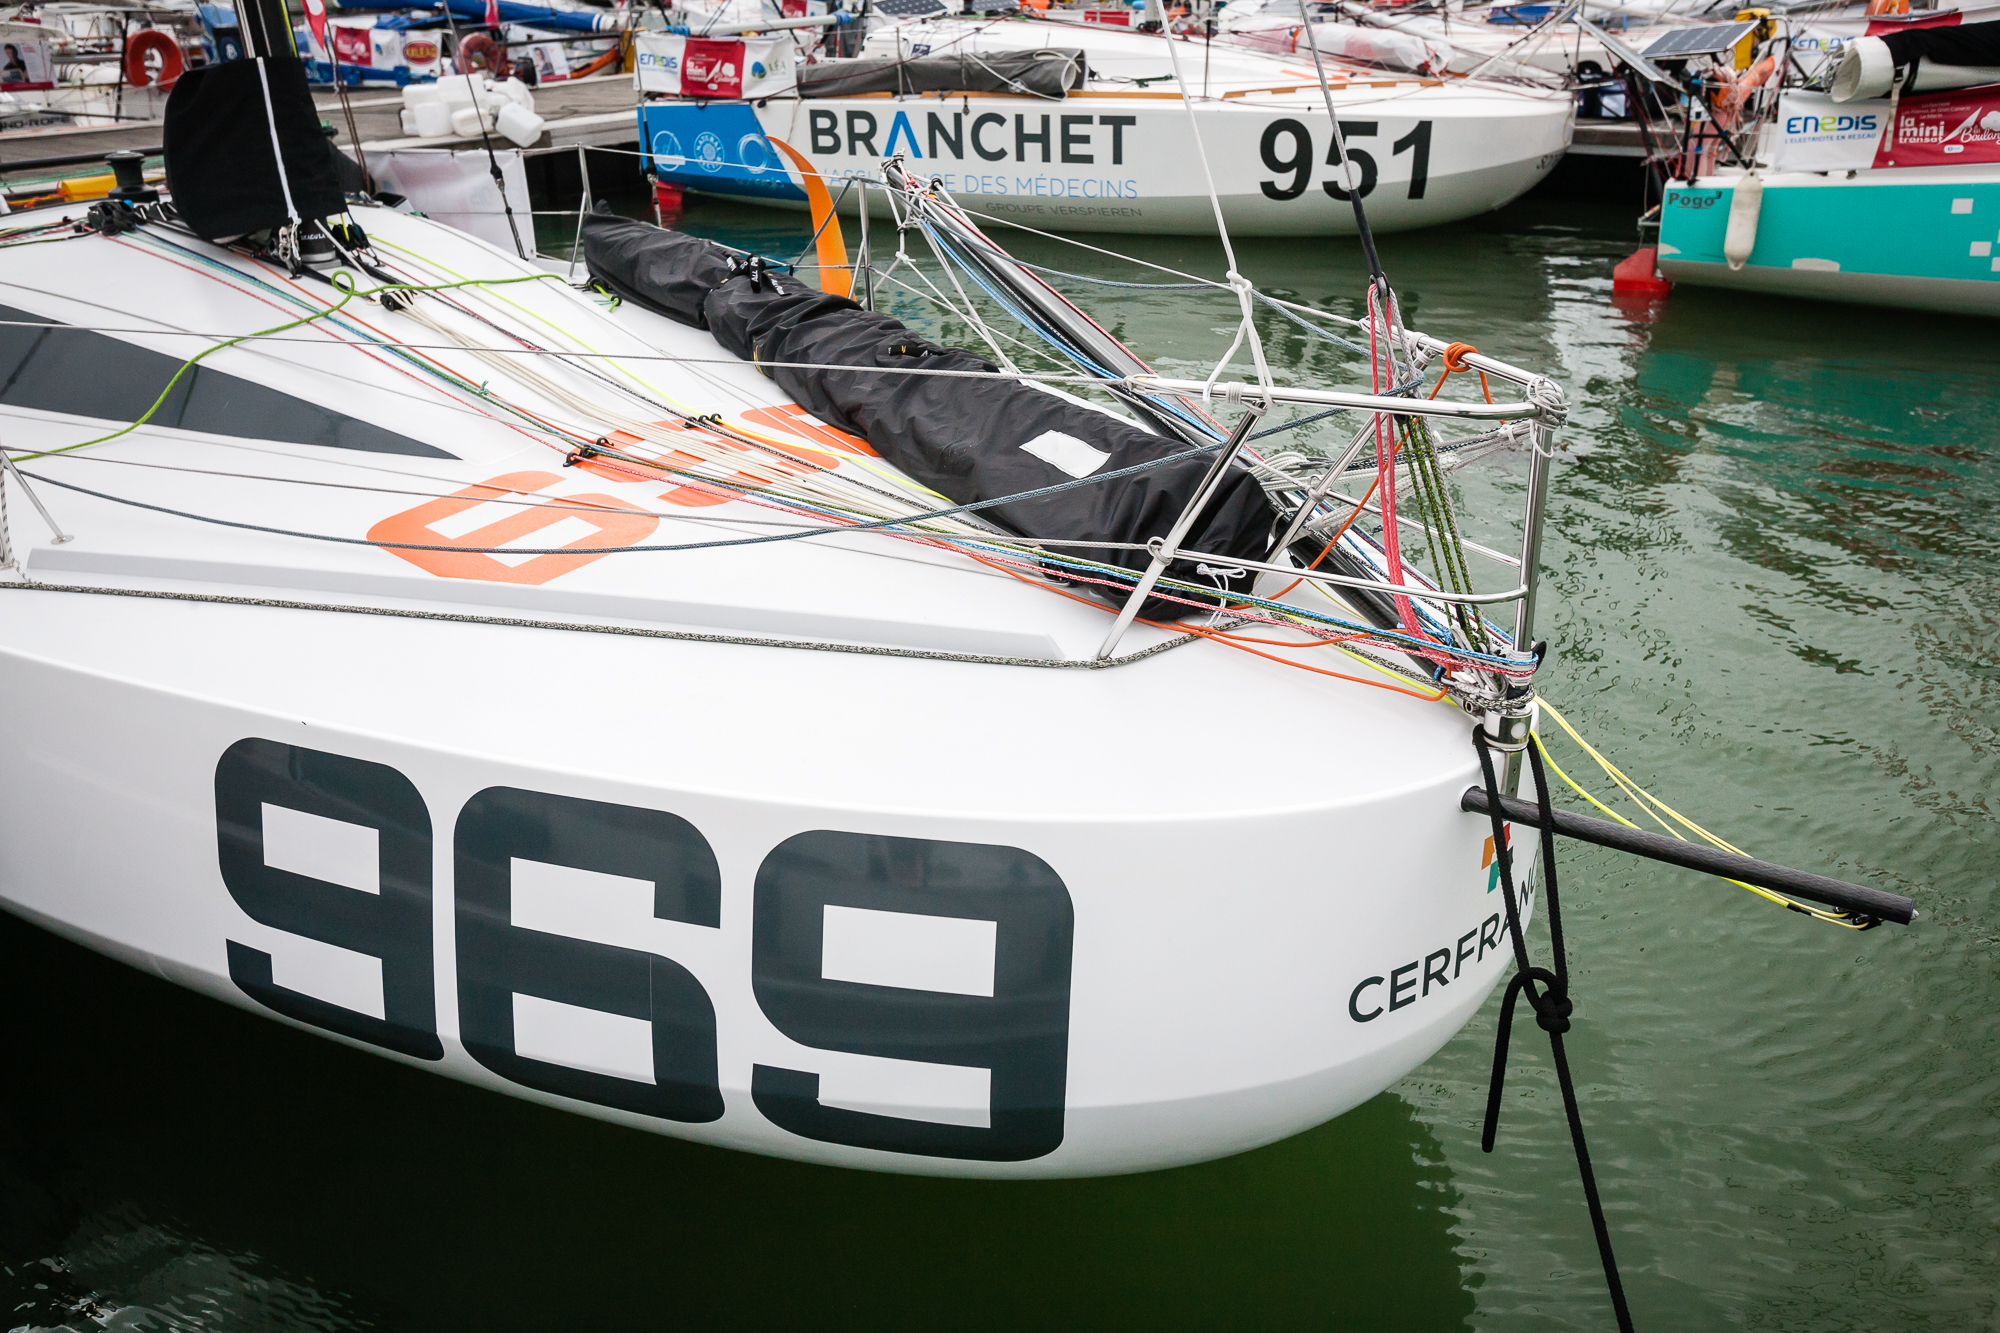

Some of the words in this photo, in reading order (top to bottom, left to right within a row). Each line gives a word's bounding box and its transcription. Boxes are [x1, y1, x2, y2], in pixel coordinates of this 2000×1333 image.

[1899, 121, 1945, 137] mini
[1900, 115, 1915, 127] la
[809, 109, 1137, 165] BRANCHET
[1899, 136, 1943, 144] transat
[1259, 118, 1433, 201] 951
[964, 174, 1008, 195] DES
[1016, 173, 1138, 199] MÉDECINS
[985, 202, 1046, 214] GROUPE
[1049, 205, 1142, 217] VERSPIEREN
[214, 736, 1075, 1162] 969
